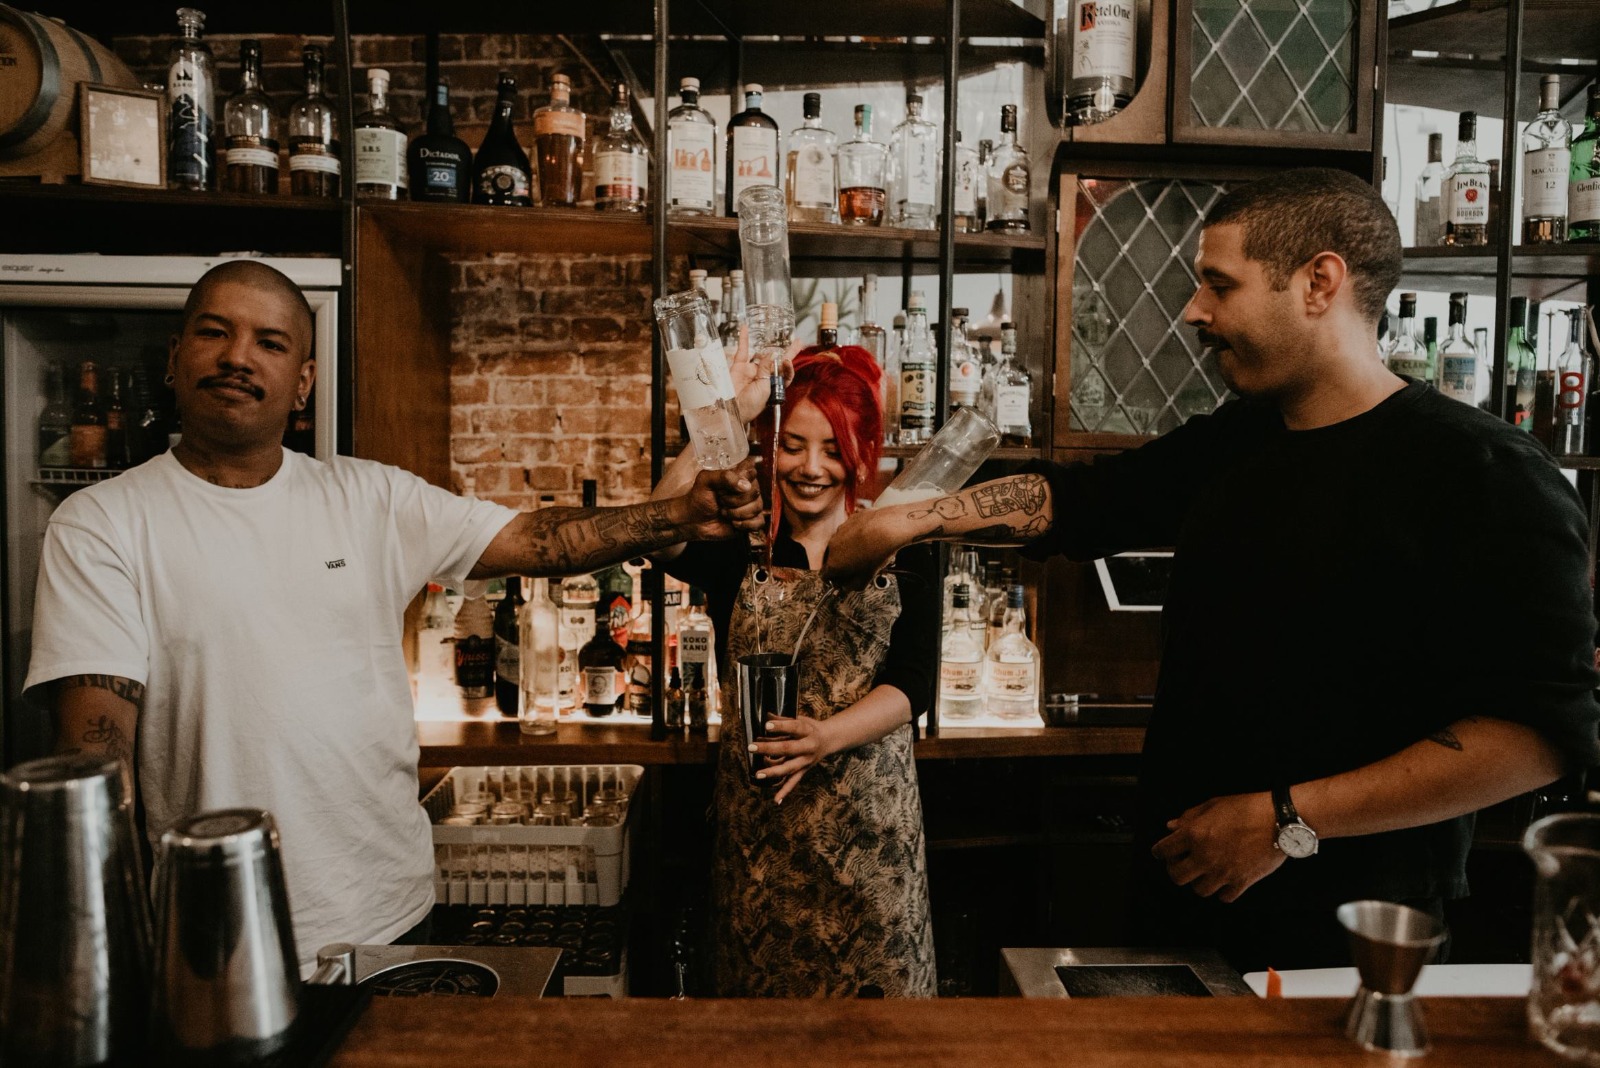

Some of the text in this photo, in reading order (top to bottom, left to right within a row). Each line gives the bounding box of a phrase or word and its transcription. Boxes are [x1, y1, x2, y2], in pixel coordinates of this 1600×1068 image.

[1081, 4, 1131, 27] Ketel One
[433, 171, 450, 182] 20
[1545, 181, 1556, 189] 12
[324, 558, 346, 569] VANS
